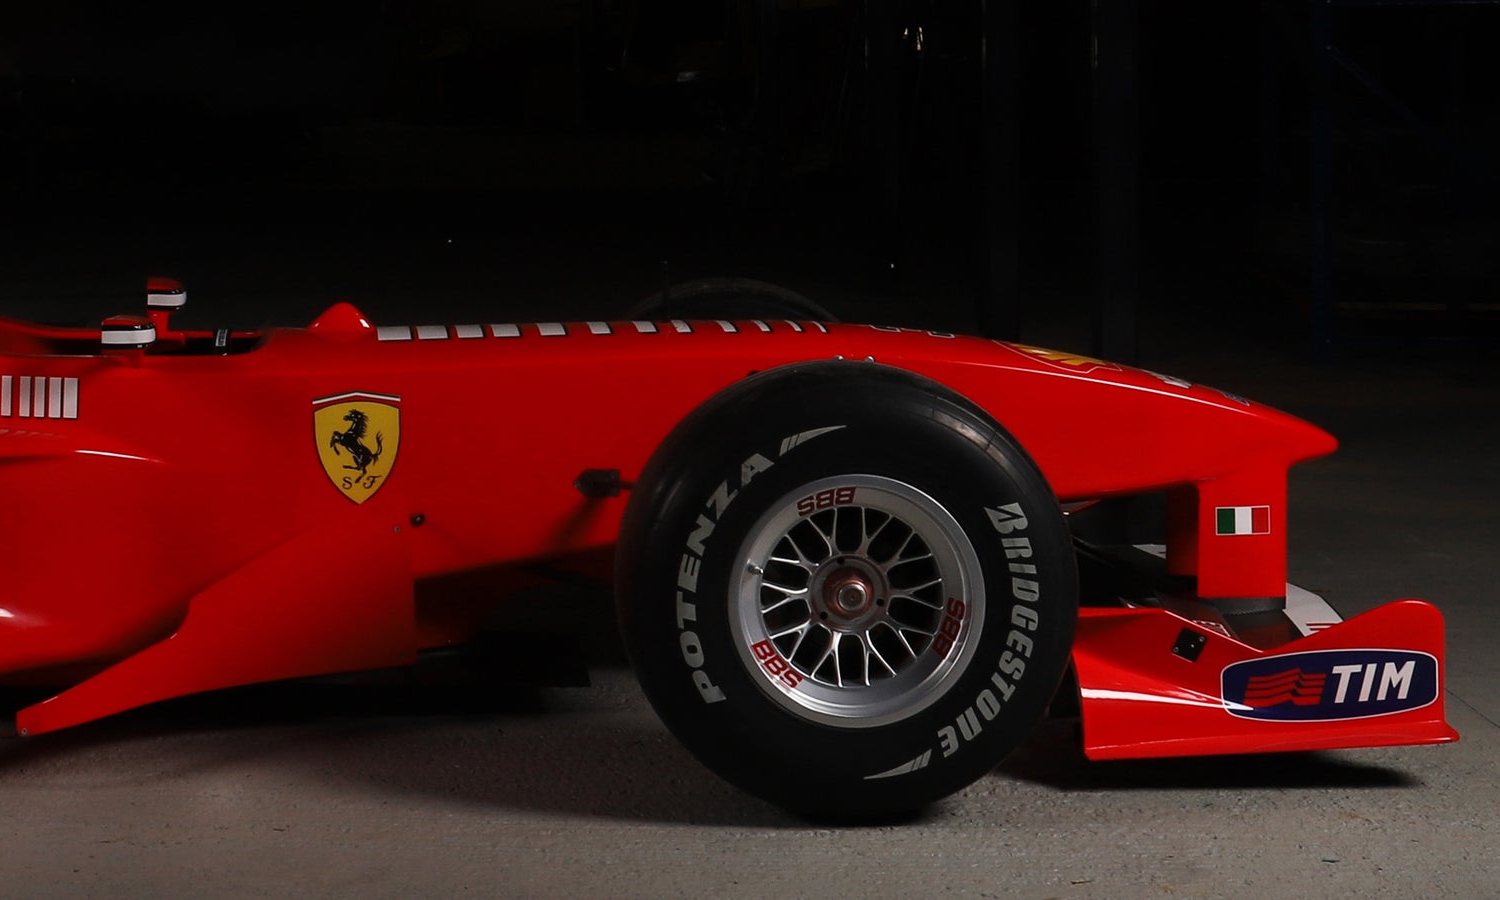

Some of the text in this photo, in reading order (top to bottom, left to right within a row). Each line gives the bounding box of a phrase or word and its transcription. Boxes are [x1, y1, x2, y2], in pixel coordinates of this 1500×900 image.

[797, 487, 856, 517] BBS
[677, 453, 774, 704] POTENZA
[932, 597, 966, 660] BBS
[751, 639, 803, 689] BBS
[1332, 661, 1416, 704] TIM
